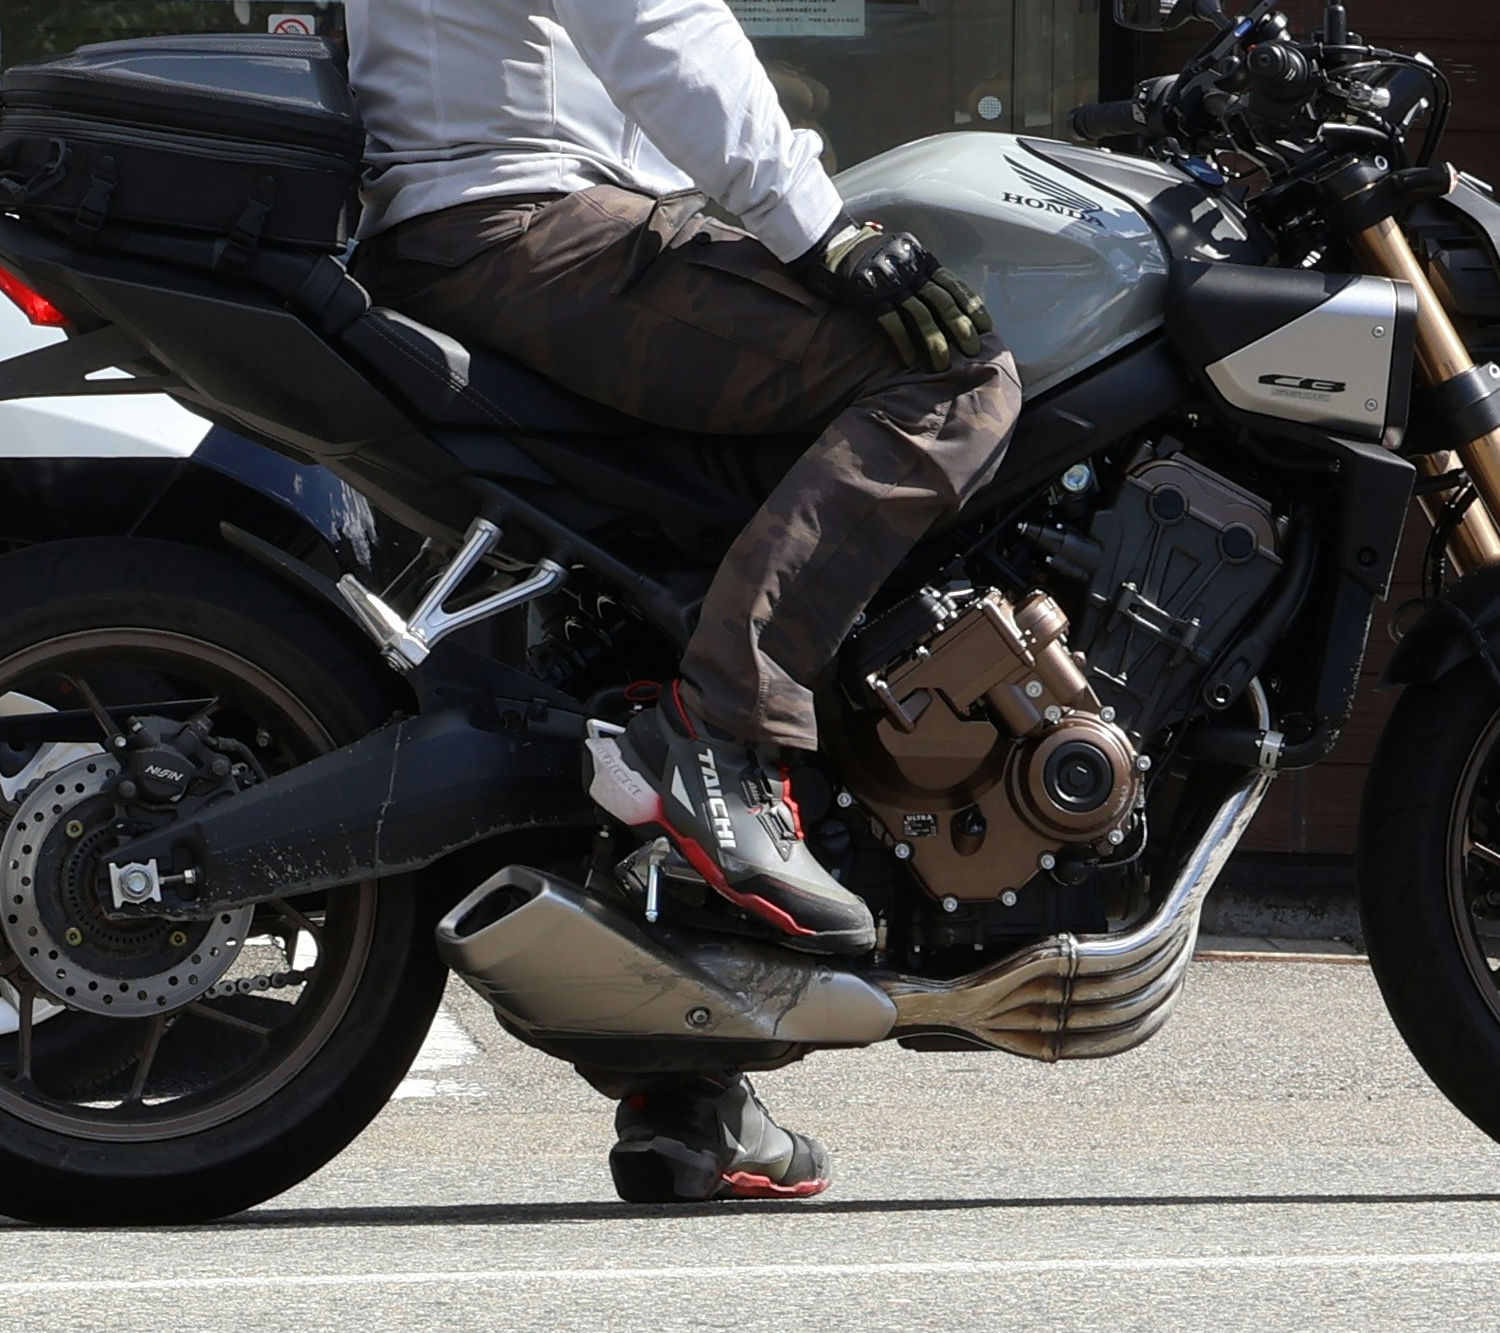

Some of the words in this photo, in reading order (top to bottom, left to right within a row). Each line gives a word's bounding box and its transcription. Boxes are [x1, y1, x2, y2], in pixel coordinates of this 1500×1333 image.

[1002, 192, 1107, 230] HONDA
[1258, 374, 1346, 393] CB
[697, 748, 737, 849] TAICHI
[906, 814, 933, 822] ULTRA
